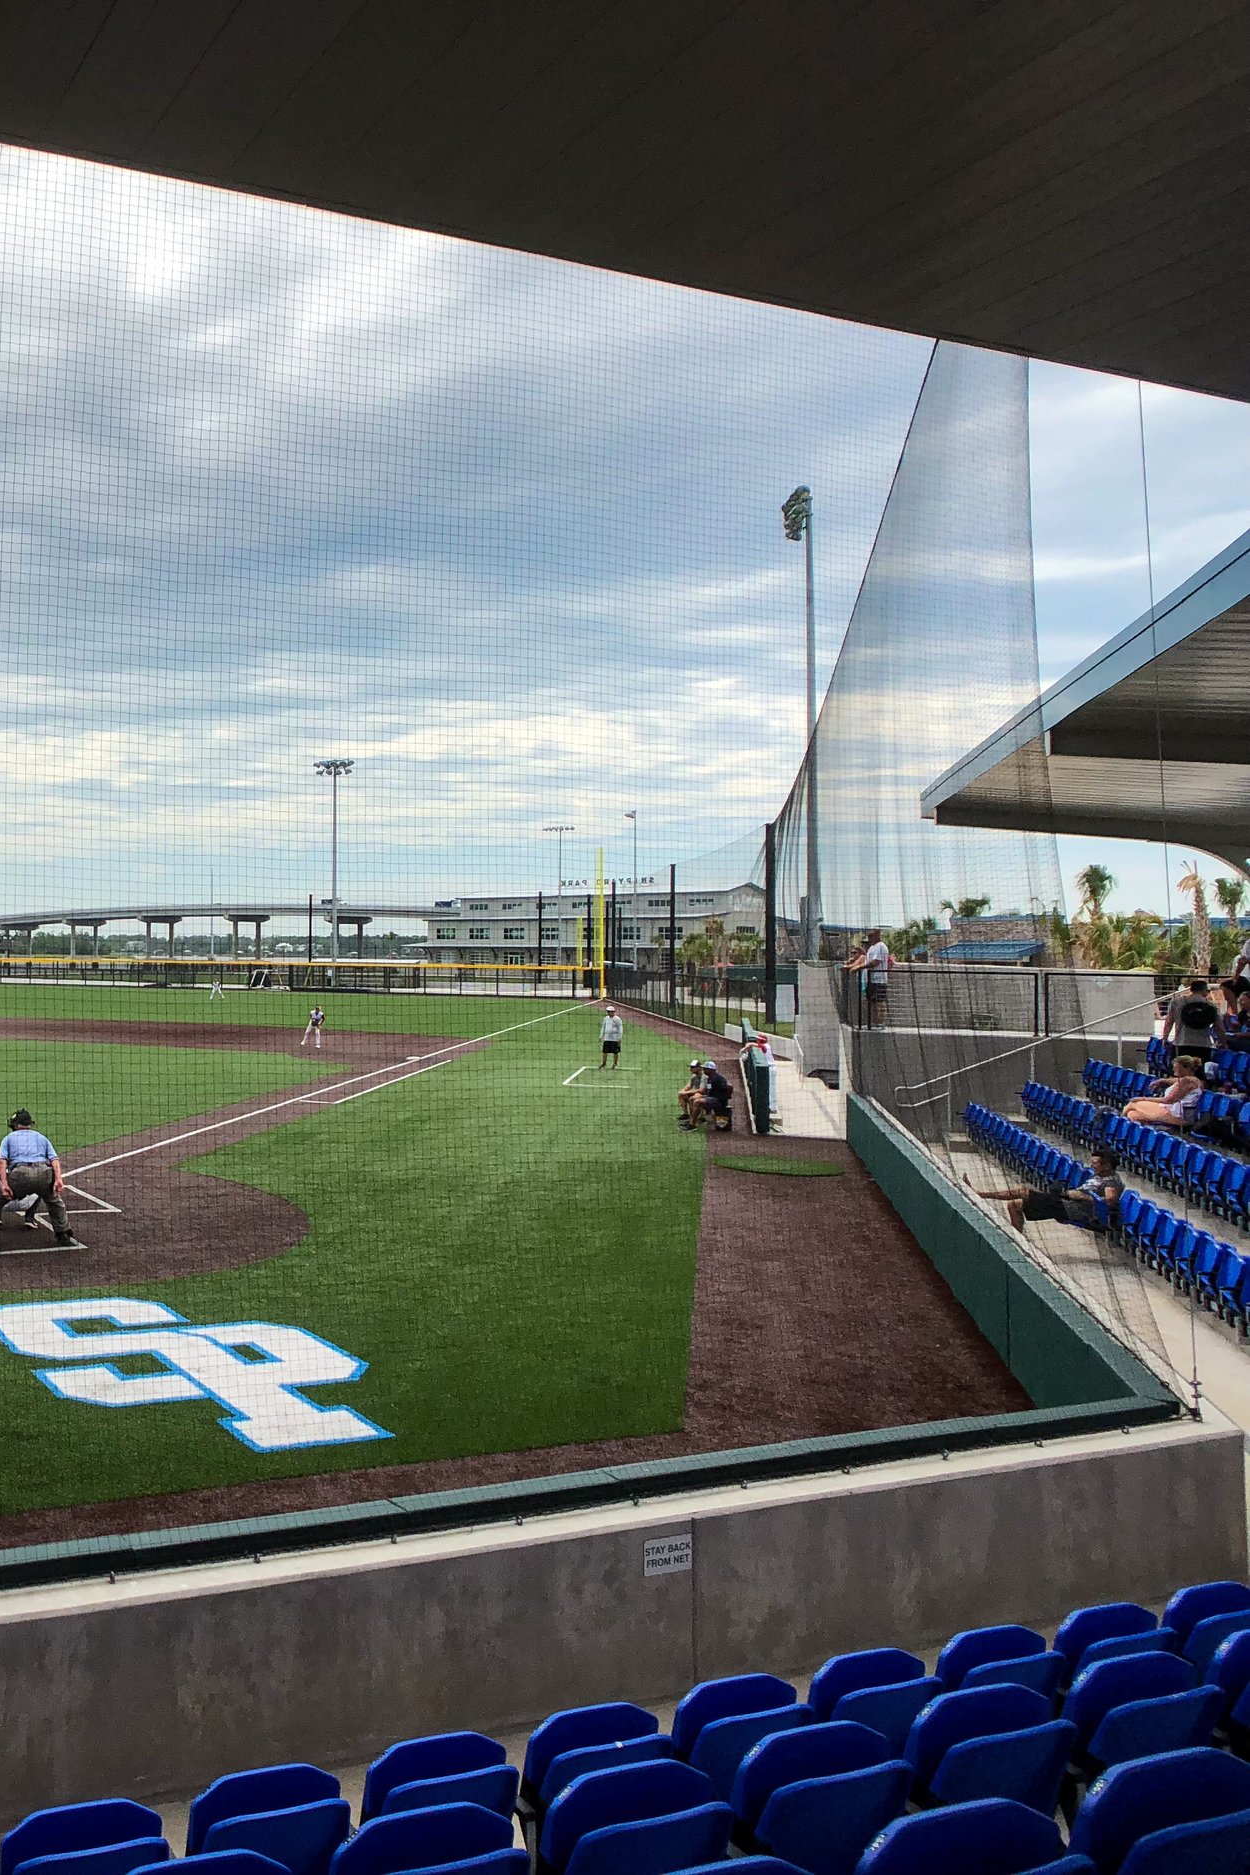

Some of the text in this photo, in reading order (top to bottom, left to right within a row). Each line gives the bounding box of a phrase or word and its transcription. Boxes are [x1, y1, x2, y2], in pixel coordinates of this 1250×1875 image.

[645, 1541, 691, 1557] STAY BACK
[646, 1553, 690, 1569] FROM NET
